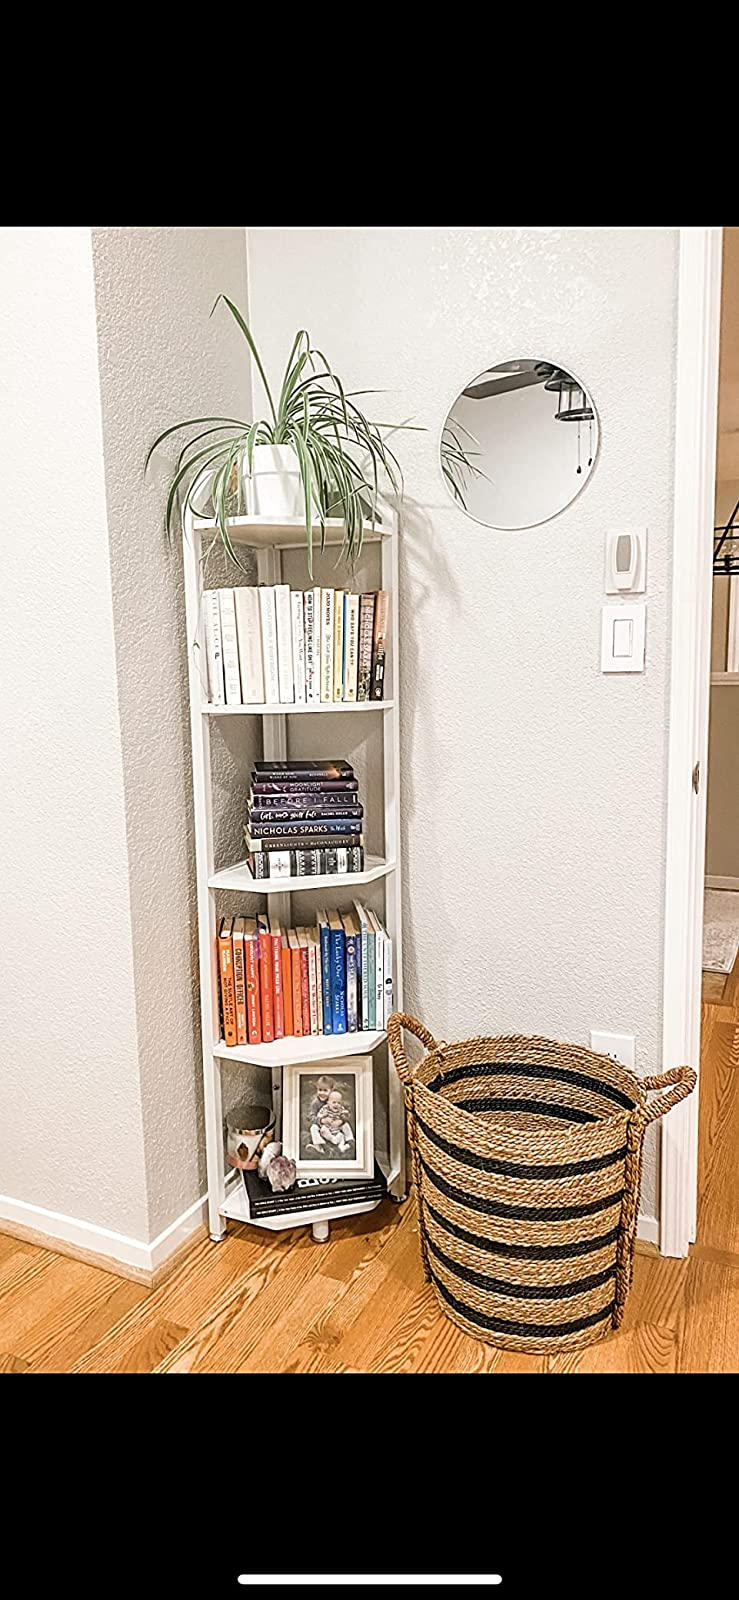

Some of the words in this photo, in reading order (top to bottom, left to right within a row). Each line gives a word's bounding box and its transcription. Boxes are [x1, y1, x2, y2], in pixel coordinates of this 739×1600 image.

[265, 797, 308, 805] BEFORE
[254, 826, 297, 835] NICHOLAS
[300, 824, 328, 833] SPARKS
[334, 934, 342, 945] The
[333, 946, 342, 964] Lucky
[235, 948, 243, 981] CORRUPTION
[335, 964, 343, 978] One
[236, 984, 244, 1005] OFFICER
